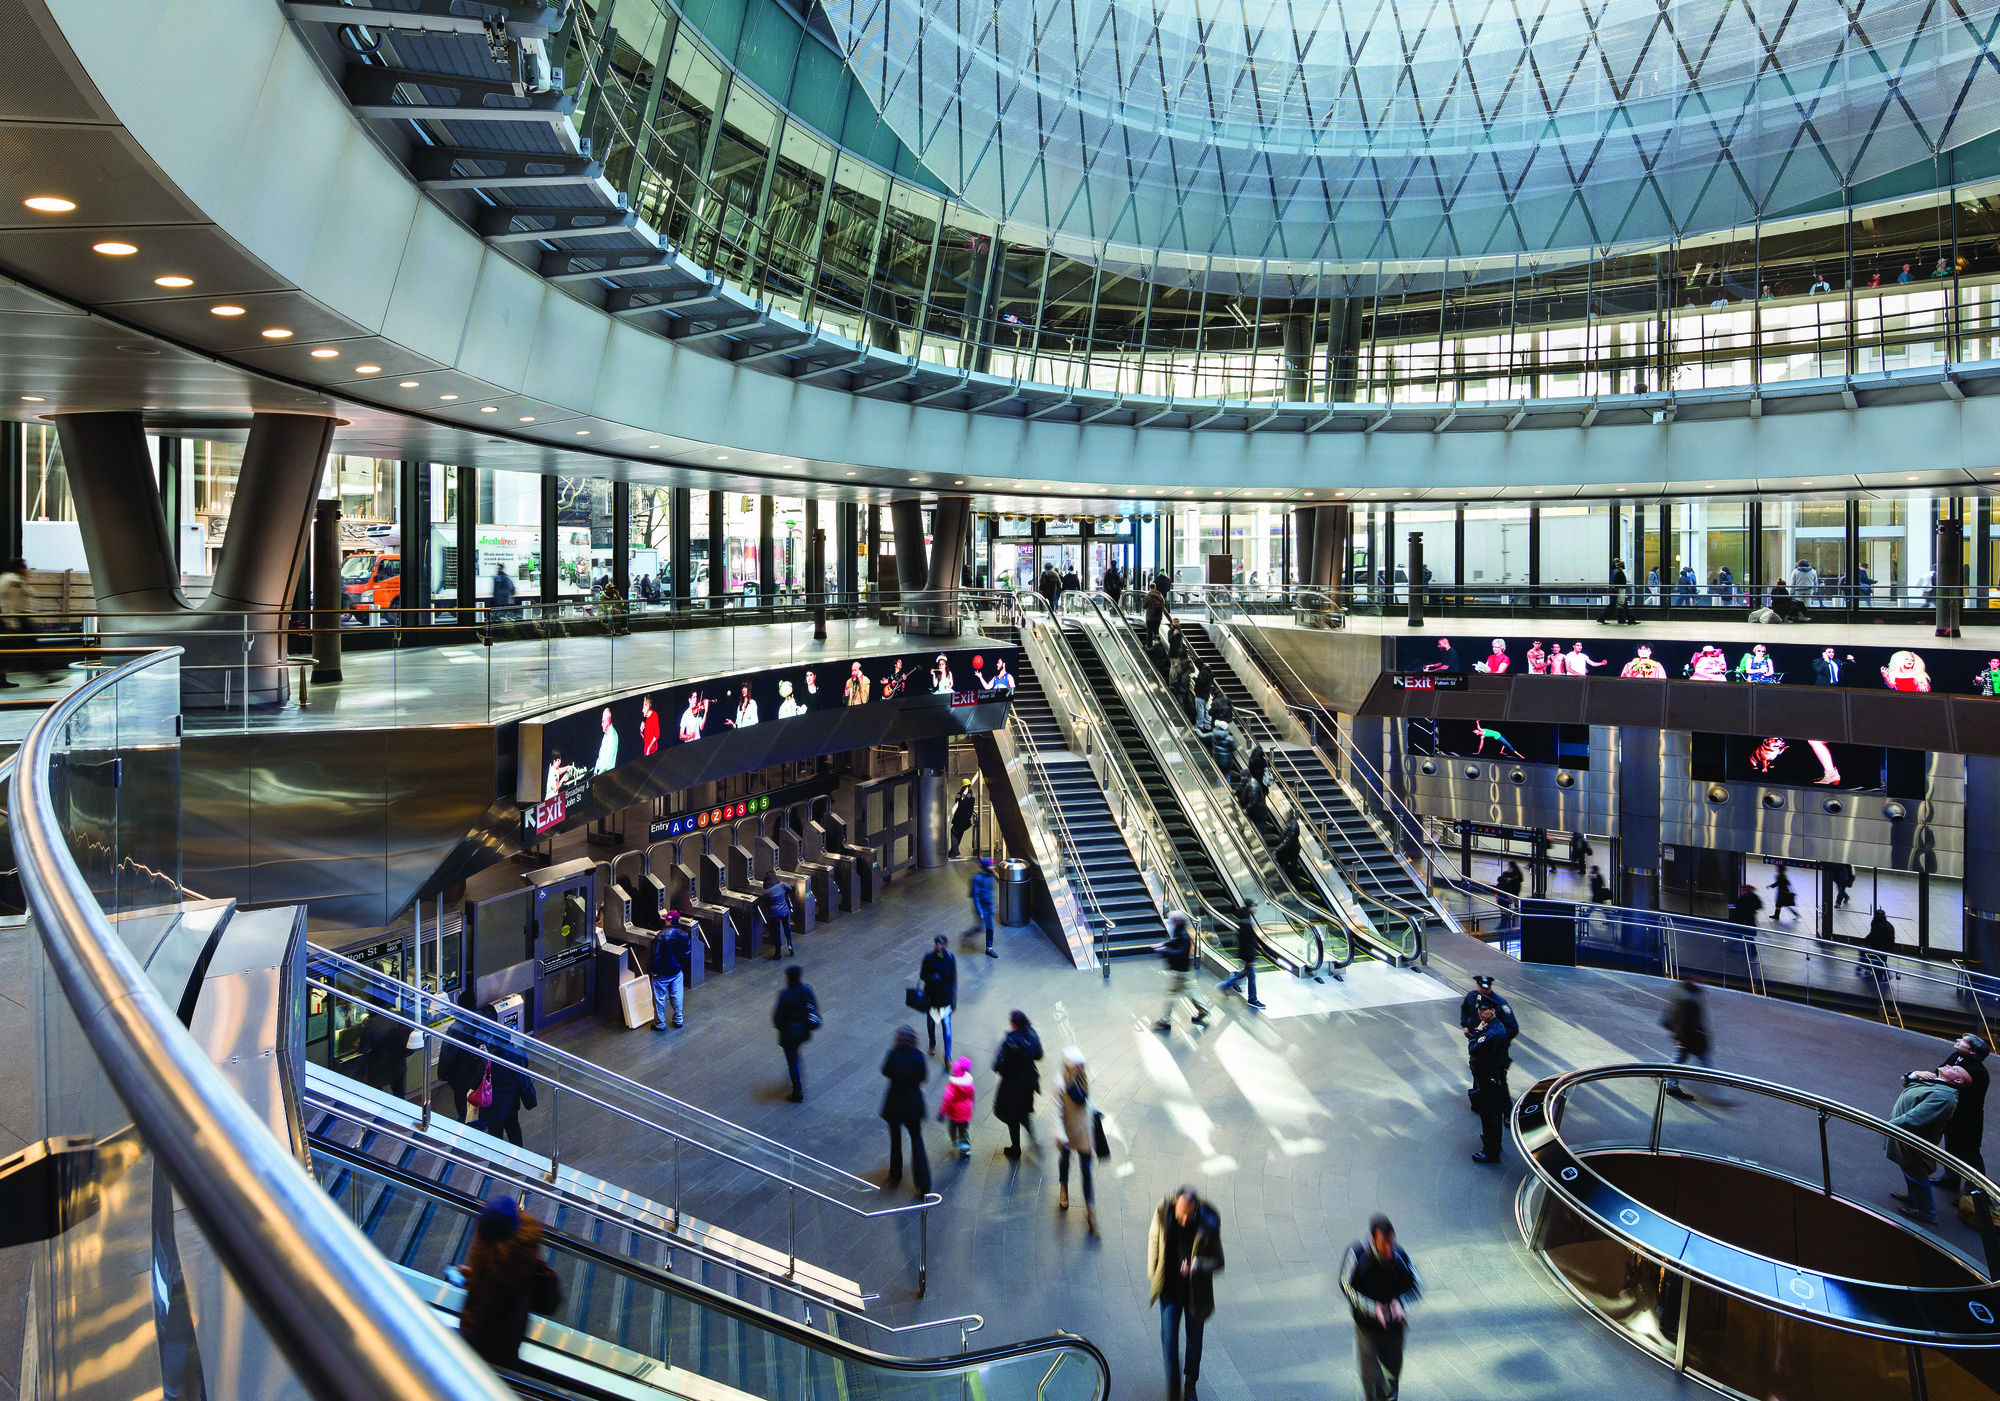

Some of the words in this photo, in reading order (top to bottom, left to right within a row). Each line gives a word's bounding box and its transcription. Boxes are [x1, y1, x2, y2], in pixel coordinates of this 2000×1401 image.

[481, 536, 517, 545] freshdirect
[1404, 676, 1432, 688] Exit
[952, 690, 975, 704] Exit
[565, 784, 585, 799] Broadway
[586, 781, 589, 789] &
[565, 797, 576, 808] John
[576, 793, 582, 803] St
[537, 796, 562, 829] Exit
[650, 821, 670, 833] Entry
[386, 939, 402, 948] Booth
[367, 946, 378, 957] St
[504, 1014, 518, 1022] Entry
